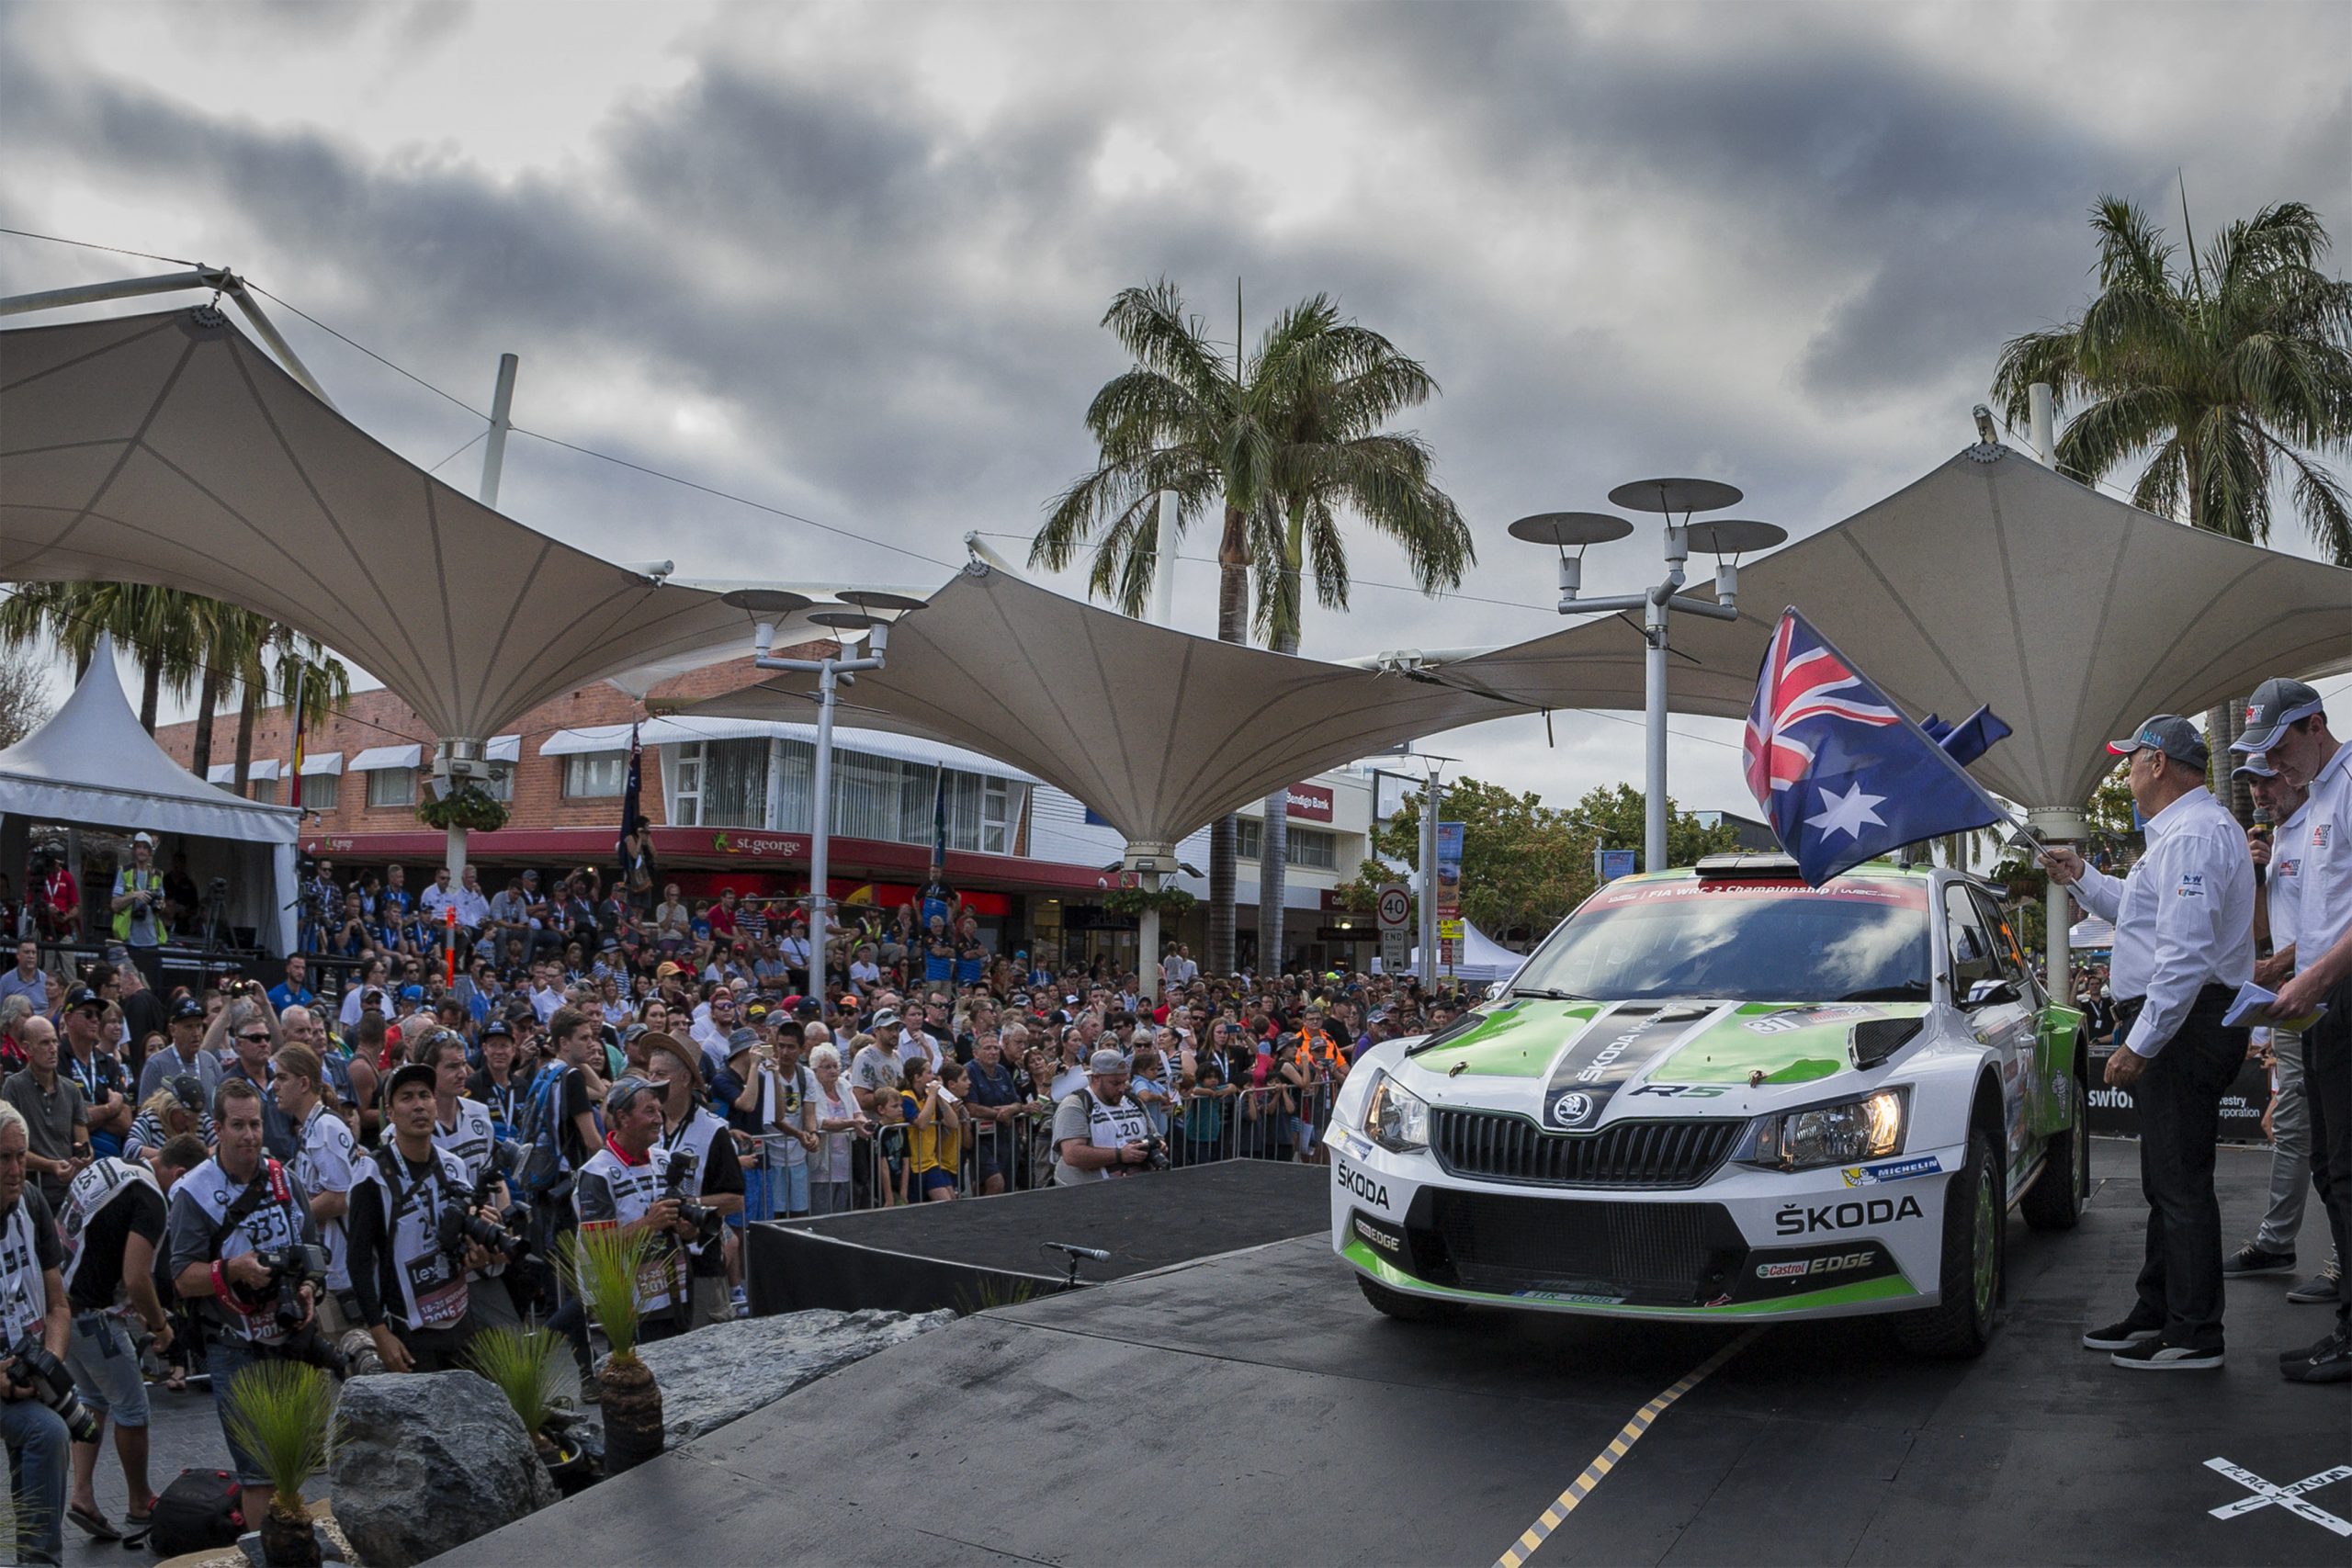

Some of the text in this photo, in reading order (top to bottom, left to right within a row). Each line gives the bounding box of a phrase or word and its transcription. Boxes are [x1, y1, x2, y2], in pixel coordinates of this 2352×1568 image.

[1312, 796, 1329, 810] Bank
[737, 837, 800, 856] st.george
[1648, 886, 1830, 898] FIA WRC 2 Championship
[1384, 899, 1405, 914] 40
[1385, 932, 1402, 941] END
[1576, 1033, 1640, 1082] ŠKODA
[1628, 1085, 1733, 1098] R5
[1878, 1159, 1938, 1177] MICHELIN
[1338, 1158, 1390, 1210] ŠKODA
[1775, 1195, 1924, 1235] ŠKODA
[246, 1212, 287, 1246] 233
[1371, 1229, 1400, 1251] EDGE
[1770, 1250, 1876, 1276] Castrol EDGE
[2220, 1465, 2271, 1490] FLAG
